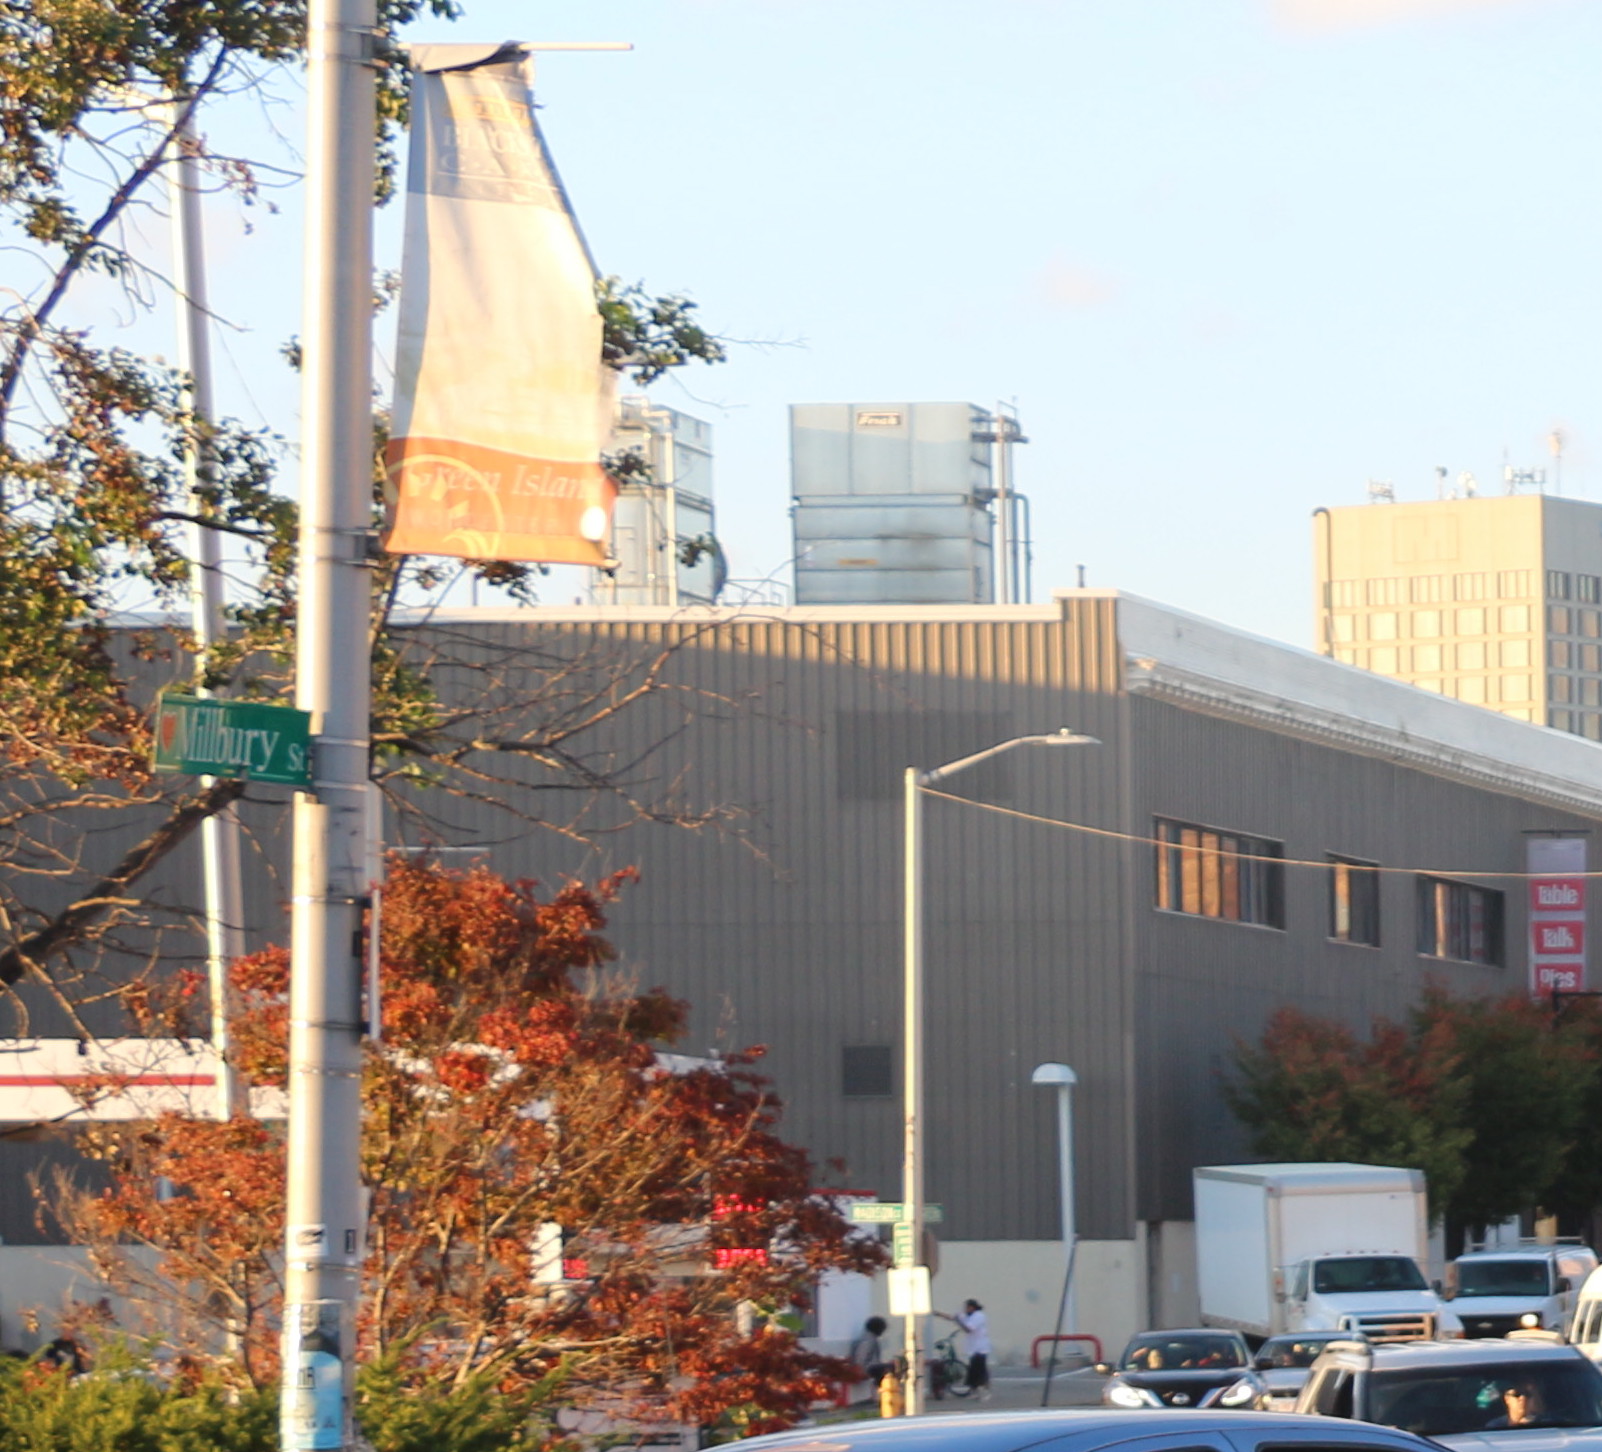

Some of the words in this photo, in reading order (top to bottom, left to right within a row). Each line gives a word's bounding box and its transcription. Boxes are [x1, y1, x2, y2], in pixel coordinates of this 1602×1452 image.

[405, 463, 500, 490] Green
[172, 706, 280, 772] Millbury
[1538, 884, 1579, 905] Table
[1542, 926, 1576, 948] Talk
